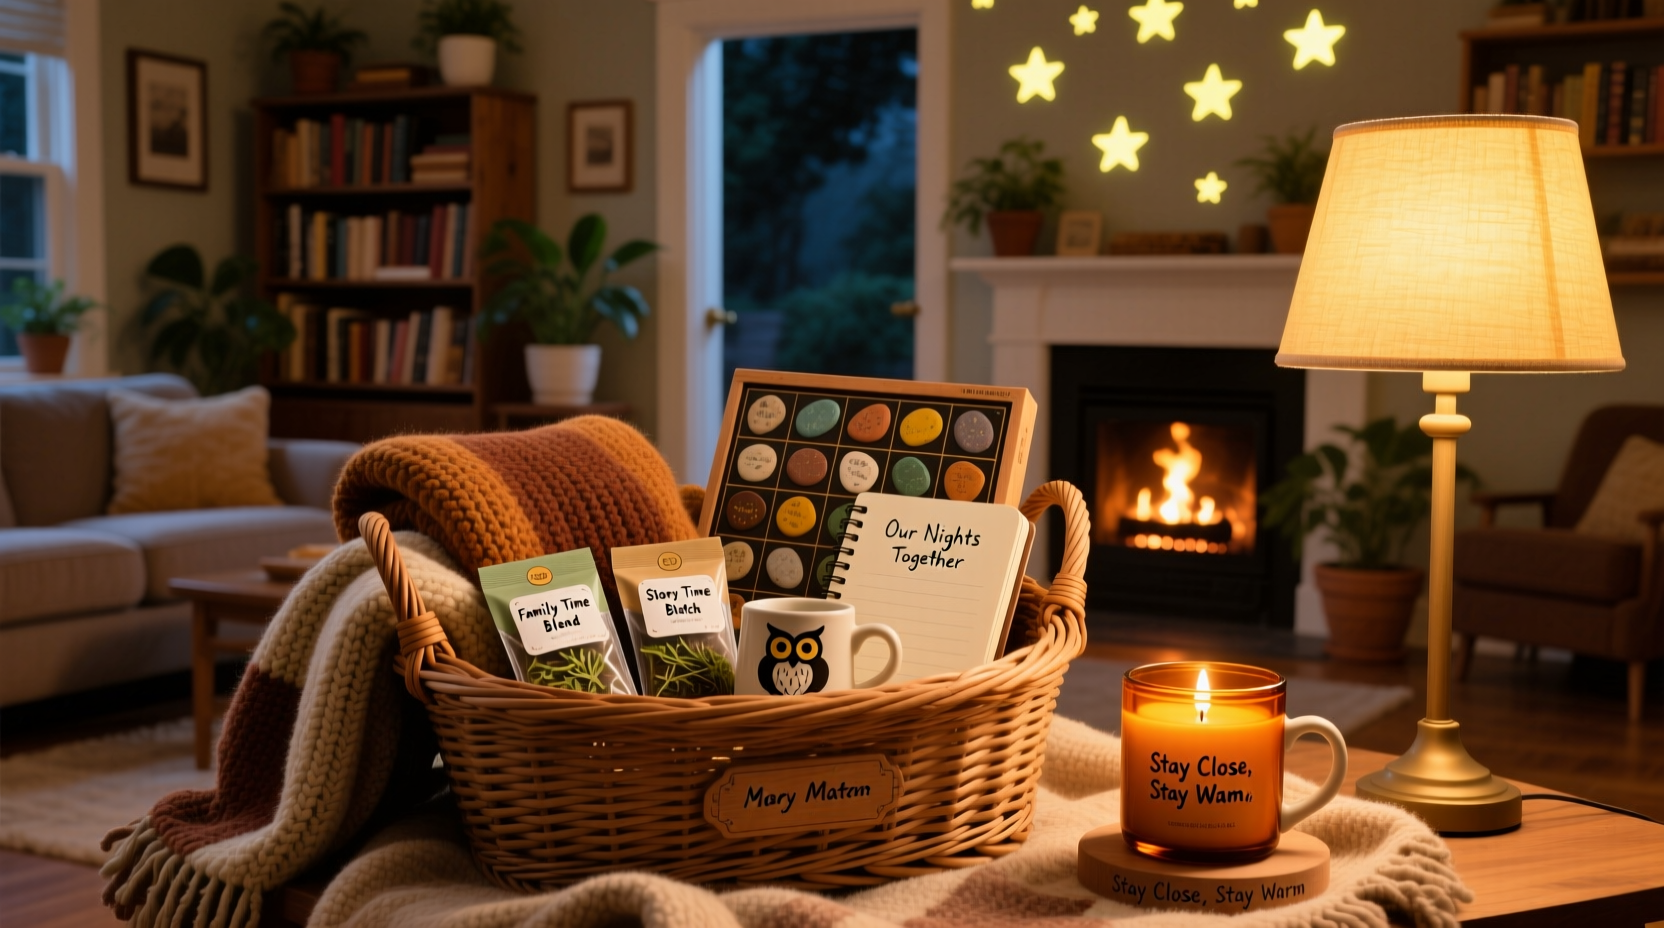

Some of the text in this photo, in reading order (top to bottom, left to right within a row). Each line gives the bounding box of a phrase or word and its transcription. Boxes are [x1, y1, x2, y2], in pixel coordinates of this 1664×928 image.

[885, 518, 981, 551] Our Nights
[892, 546, 965, 571] Together
[681, 585, 711, 598] Time
[518, 597, 590, 622] Family Time
[543, 615, 580, 632] Blend
[1150, 751, 1252, 783] Stay Close,
[1150, 778, 1188, 810] Stay
[1112, 874, 1305, 910] Stay Close, Stay Warm
